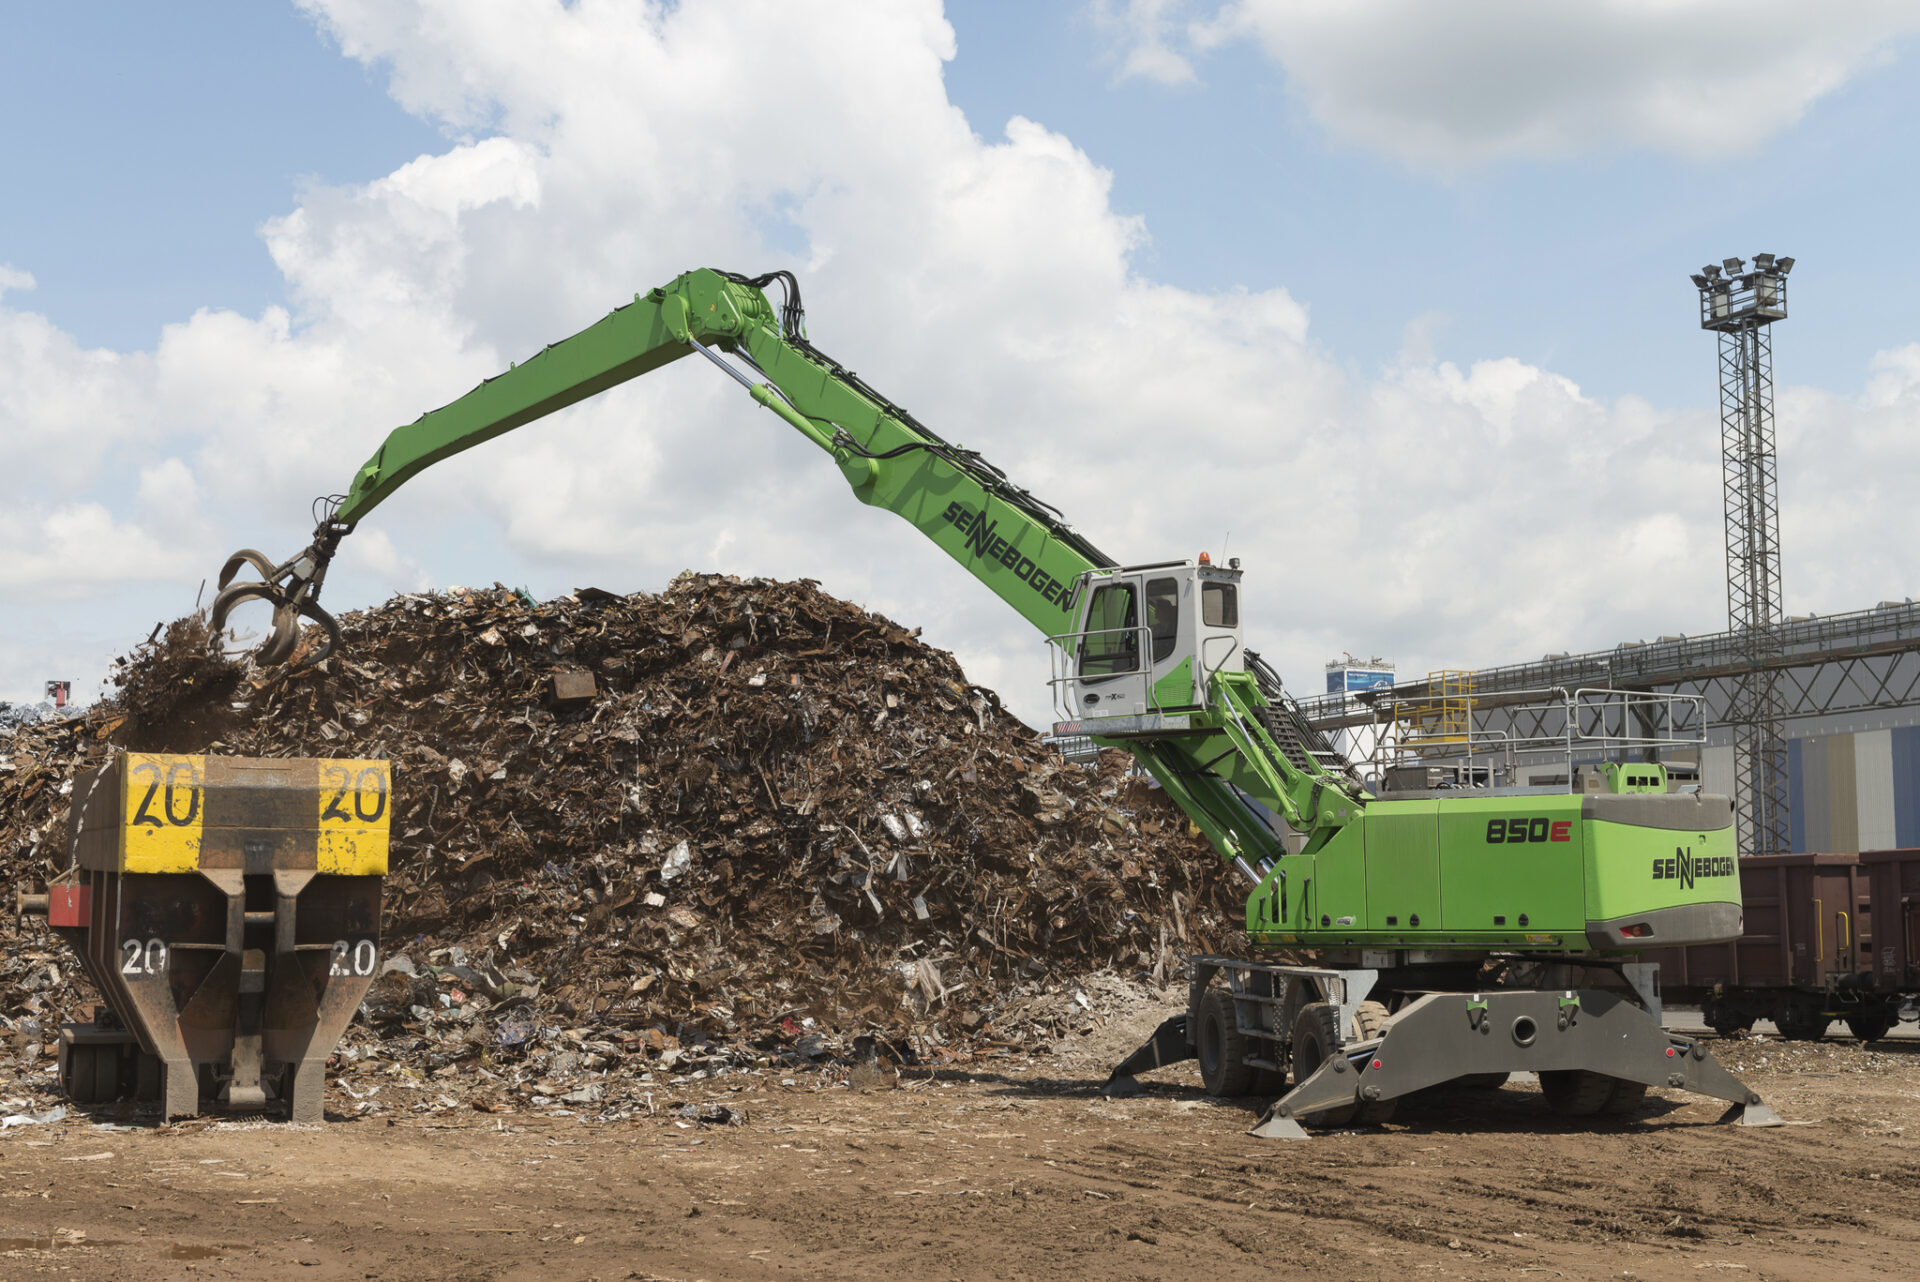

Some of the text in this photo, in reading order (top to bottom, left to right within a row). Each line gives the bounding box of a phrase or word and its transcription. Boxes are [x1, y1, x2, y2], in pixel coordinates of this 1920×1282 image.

[942, 501, 1072, 613] SENNEBOGEN
[132, 763, 199, 828] 20
[321, 766, 387, 823] 20
[1486, 817, 1572, 844] 850E
[1652, 847, 1736, 890] SENNEBOGEN
[121, 938, 167, 975] 20
[329, 939, 376, 977] 20
